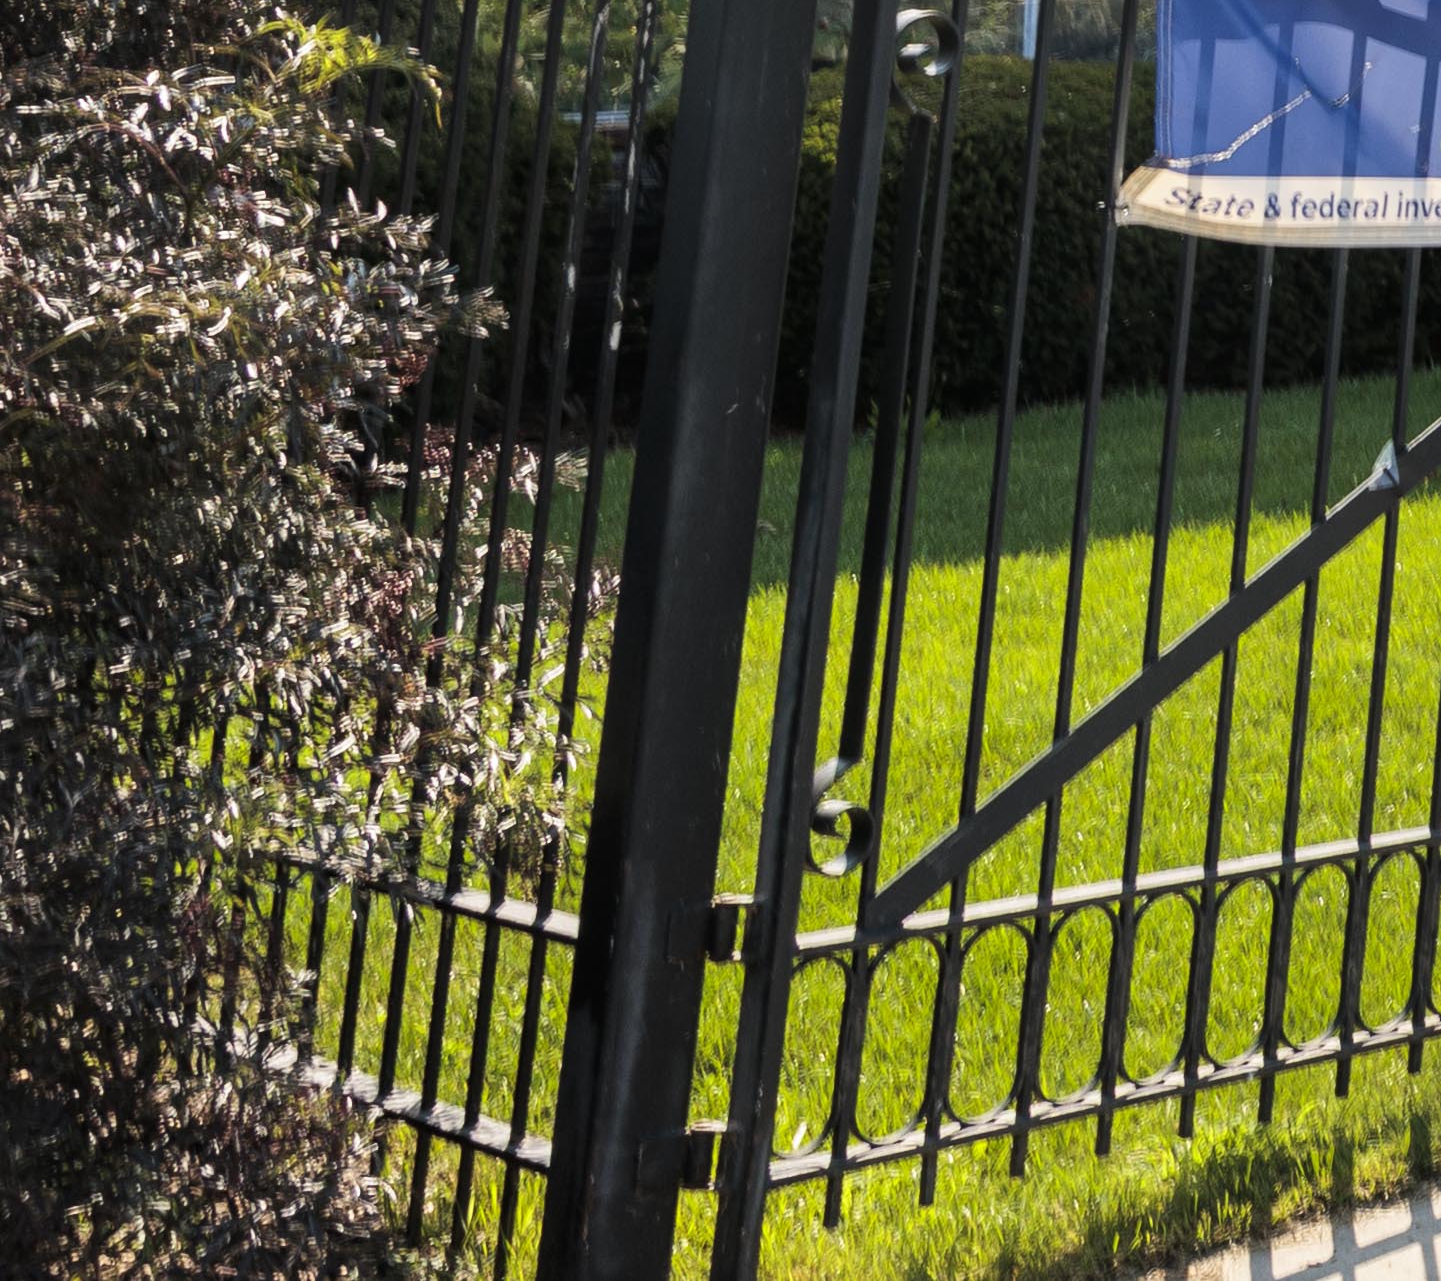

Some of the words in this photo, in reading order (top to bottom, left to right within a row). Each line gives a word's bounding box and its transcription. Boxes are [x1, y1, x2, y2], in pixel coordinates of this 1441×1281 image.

[1164, 185, 1256, 219] State
[1263, 192, 1281, 220] &
[1291, 191, 1389, 221] federal
